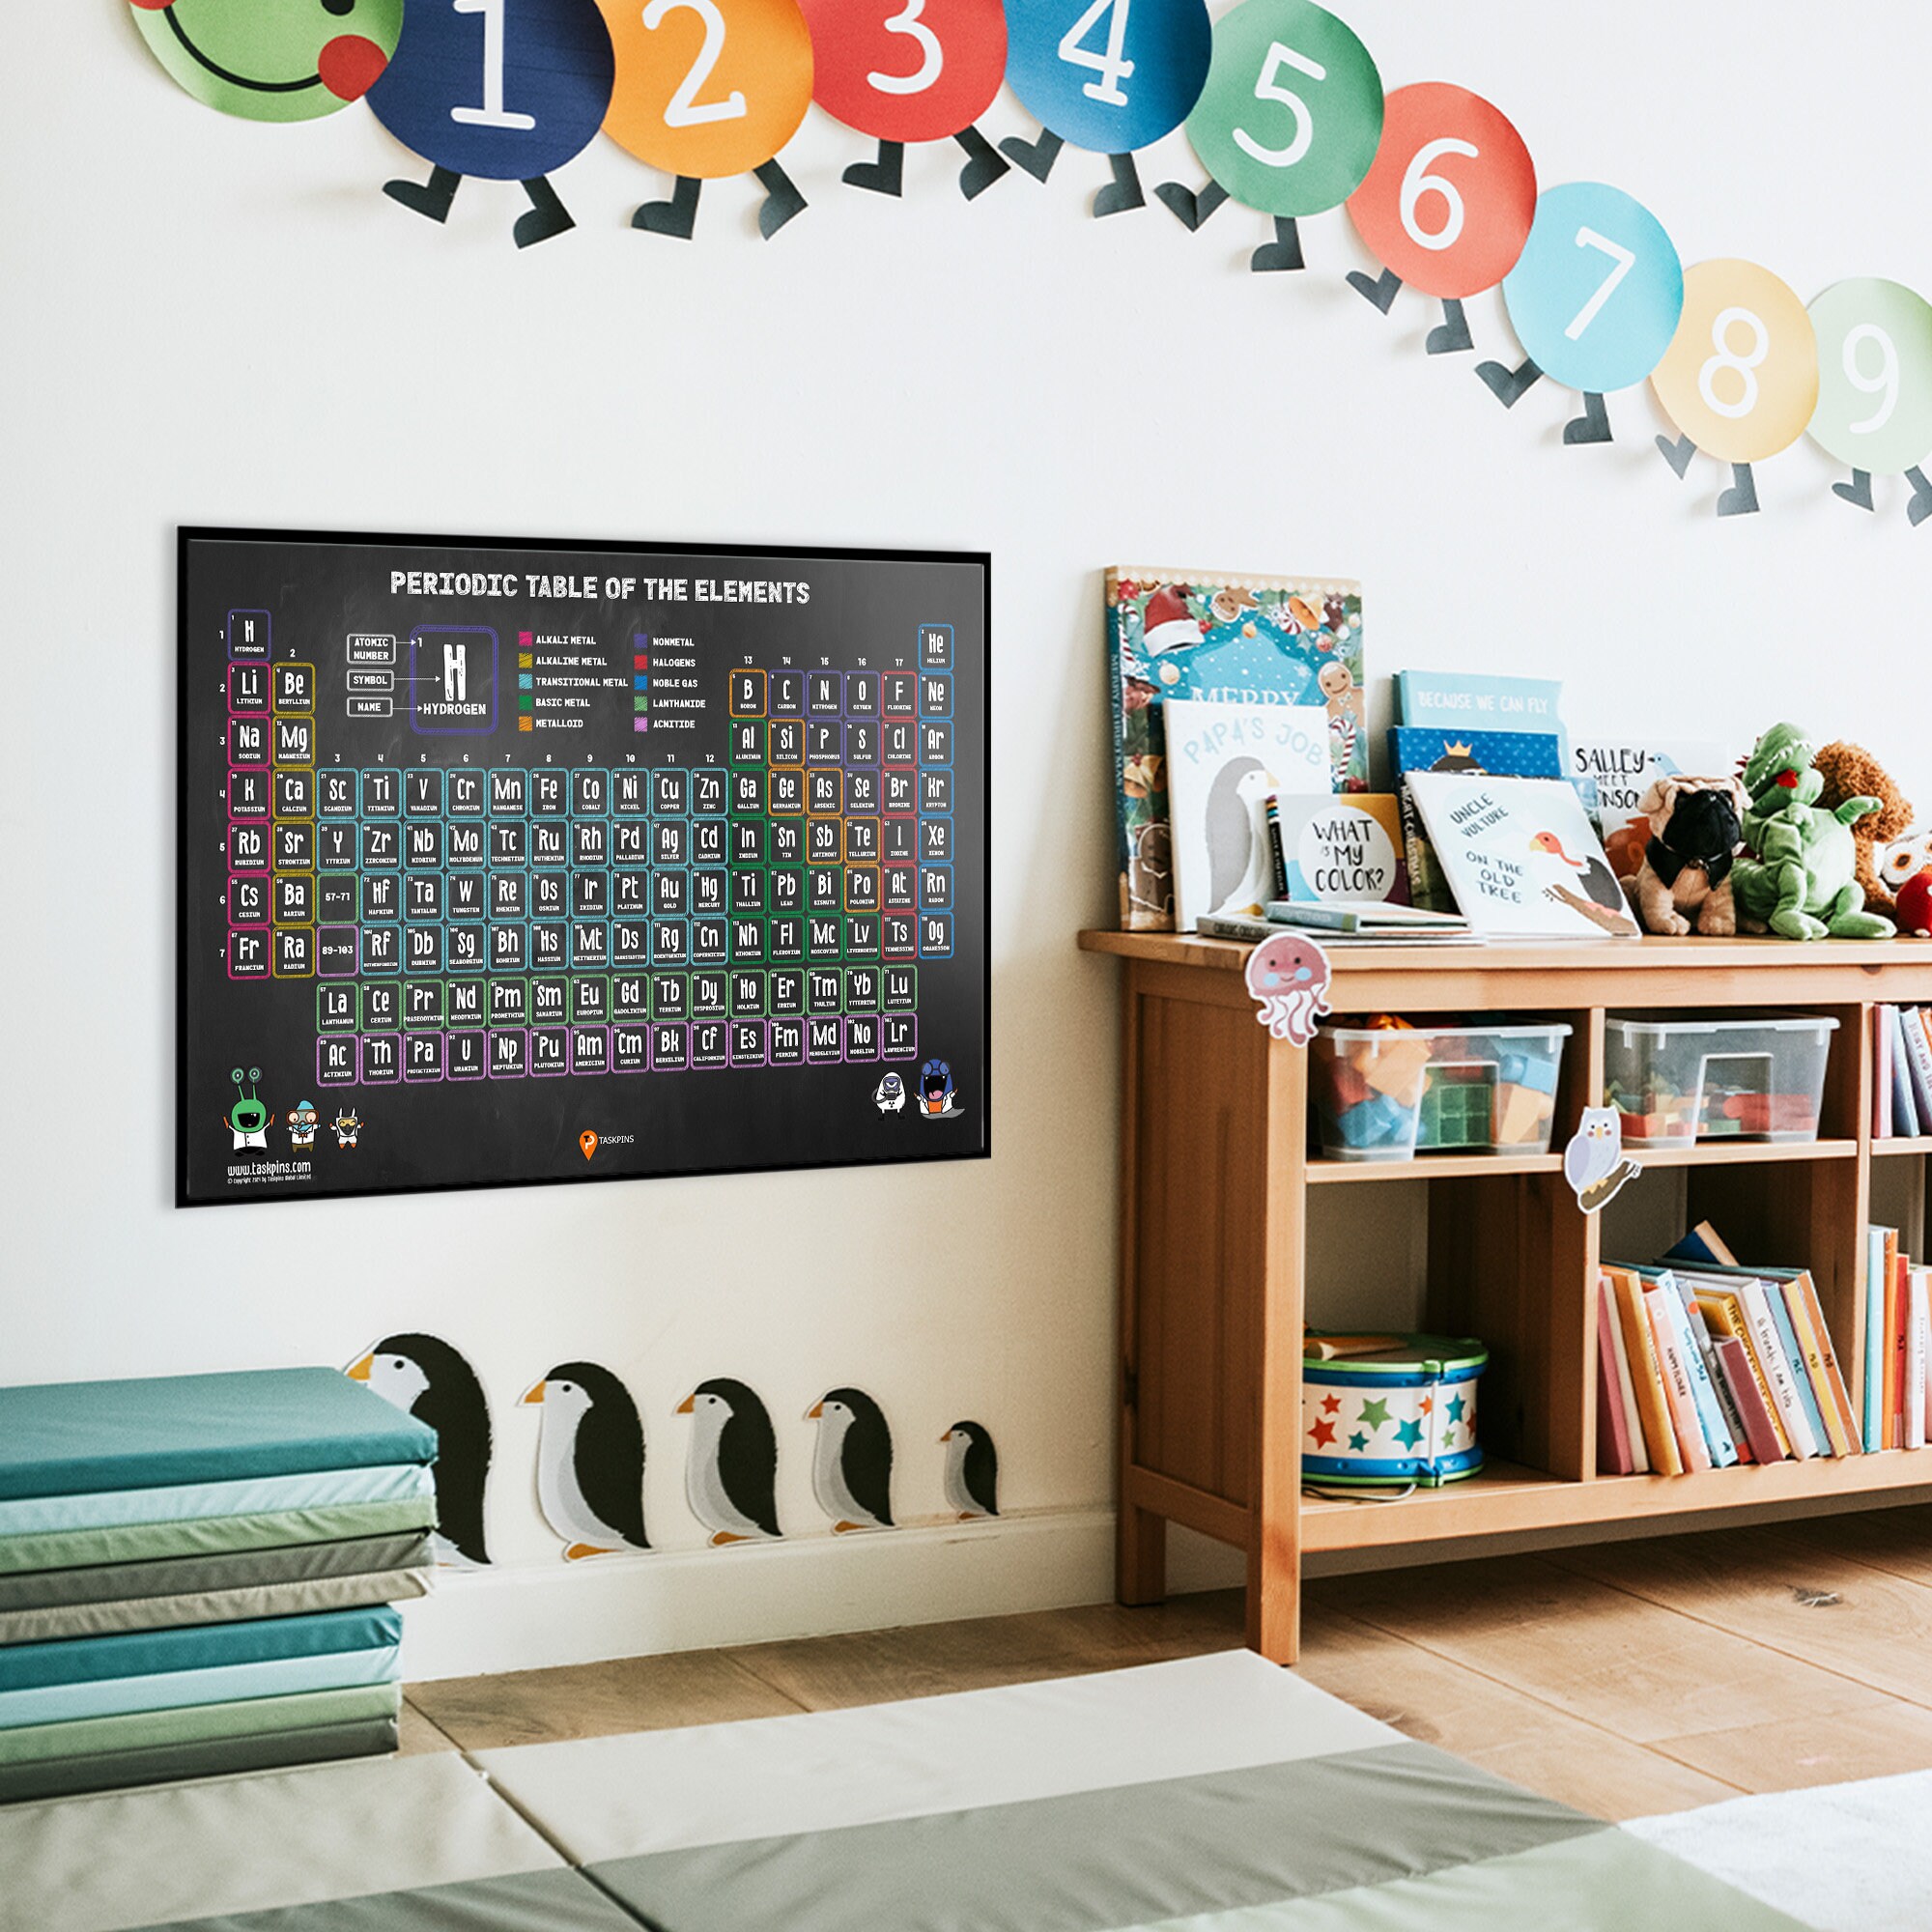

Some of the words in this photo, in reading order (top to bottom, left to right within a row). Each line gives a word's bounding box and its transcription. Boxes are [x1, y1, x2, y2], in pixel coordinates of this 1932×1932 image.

[867, 0, 944, 95] 3
[1058, 0, 1135, 107] 4
[450, 0, 536, 130] 1
[641, 0, 747, 128] 2
[1233, 42, 1326, 167] 5
[1400, 138, 1479, 250] 6
[1564, 226, 1636, 341] 7
[1698, 307, 1769, 418] 8
[1842, 324, 1899, 434] 9
[391, 571, 518, 596] PERIODIC
[526, 575, 597, 598] TABLE
[606, 577, 636, 599] OF
[643, 579, 688, 601] THE
[696, 580, 810, 604] ELEMENTS
[219, 630, 224, 639] 1
[245, 620, 254, 641] H
[536, 635, 568, 645] ALKALI
[570, 635, 597, 645] METAL
[354, 636, 390, 647] ATOMIC
[417, 637, 423, 648] 1
[653, 637, 695, 647] NONMETAL
[928, 634, 943, 653] He
[289, 649, 296, 657] 2
[353, 651, 389, 660] NUMBER
[536, 656, 579, 666] ALKALINE
[581, 656, 607, 666] METAL
[653, 657, 696, 667] HALOGENS
[743, 655, 753, 664] 13
[782, 656, 791, 665] 14
[821, 656, 829, 666] 15
[857, 657, 867, 666] 16
[895, 658, 904, 667] 17
[242, 669, 257, 694] Li
[353, 675, 388, 684] SYMBOL
[443, 644, 467, 701] H
[536, 677, 601, 686] TRANSITIONAL
[602, 678, 628, 687] METAL
[653, 679, 681, 687] NOBLE
[682, 679, 698, 687] GAS
[220, 683, 226, 692] 2
[285, 672, 303, 695] Be
[744, 679, 753, 699] B
[783, 680, 790, 700] C
[820, 680, 829, 700] N
[895, 681, 903, 701] F
[928, 681, 944, 701] Ne
[357, 702, 381, 711] NAME
[423, 703, 486, 715] HYDROGEN
[536, 698, 563, 707] BASIC
[565, 698, 591, 708] METAL
[653, 699, 706, 709] LANTHANIDE
[1417, 691, 1472, 709] BECAUSE
[1476, 694, 1495, 711] WE
[1499, 696, 1523, 712] CAN
[1527, 696, 1548, 714] FLY
[536, 718, 584, 728] METALLOID
[220, 737, 226, 745] 3
[240, 725, 259, 748] Na
[282, 725, 307, 753] Mg
[743, 726, 754, 749] Al
[781, 725, 792, 749] Si
[928, 729, 944, 750] Ar
[1182, 717, 1264, 764] PAPA'S
[1276, 724, 1323, 765] JOB
[335, 753, 341, 763] 3
[377, 754, 384, 763] 4
[421, 753, 426, 763] 5
[463, 753, 469, 763] 6
[505, 754, 511, 763] 7
[545, 754, 552, 763] 8
[587, 754, 594, 763] 9
[625, 754, 635, 763] 10
[667, 754, 675, 763] 11
[706, 754, 714, 763] 12
[1576, 748, 1645, 773] SALLEY
[220, 790, 226, 798] 4
[286, 779, 303, 801] Ca
[374, 775, 388, 800] Ti
[541, 779, 557, 799] Fe
[623, 775, 637, 799] Ni
[662, 778, 679, 799] Cu
[700, 778, 719, 798] Zn
[1450, 792, 1493, 824] UNCLE
[1313, 820, 1373, 841] WHAT
[1461, 806, 1509, 838] VULTURE
[219, 843, 226, 852] 5
[239, 830, 260, 854] Rb
[285, 832, 303, 853] Sr
[371, 831, 391, 852] Zr
[454, 830, 478, 852] Mo
[662, 828, 678, 853] Ag
[779, 827, 795, 847] Sn
[1334, 844, 1363, 866] MY
[1465, 850, 1488, 866] ON
[1495, 859, 1523, 877] THE
[661, 877, 679, 898] Au
[778, 873, 795, 895] Pb
[927, 872, 945, 893] Rn
[1316, 867, 1384, 892] COLOR?
[1480, 868, 1515, 887] OLD
[242, 884, 258, 906] Cs
[285, 884, 304, 905] Ba
[325, 892, 350, 902] 57-71
[701, 877, 718, 901] Hg
[1477, 881, 1521, 904] TREE
[220, 895, 226, 905] 6
[219, 949, 226, 958] 7
[240, 937, 259, 959] Fr
[285, 936, 304, 958] Ra
[322, 945, 353, 955] 89-103
[457, 985, 475, 1009] Nd
[812, 977, 837, 996] Tm
[813, 1023, 837, 1046] Md
[371, 1040, 391, 1064] Th
[598, 1135, 634, 1144] TASKPINS
[227, 1160, 311, 1177] www.taskpins.com
